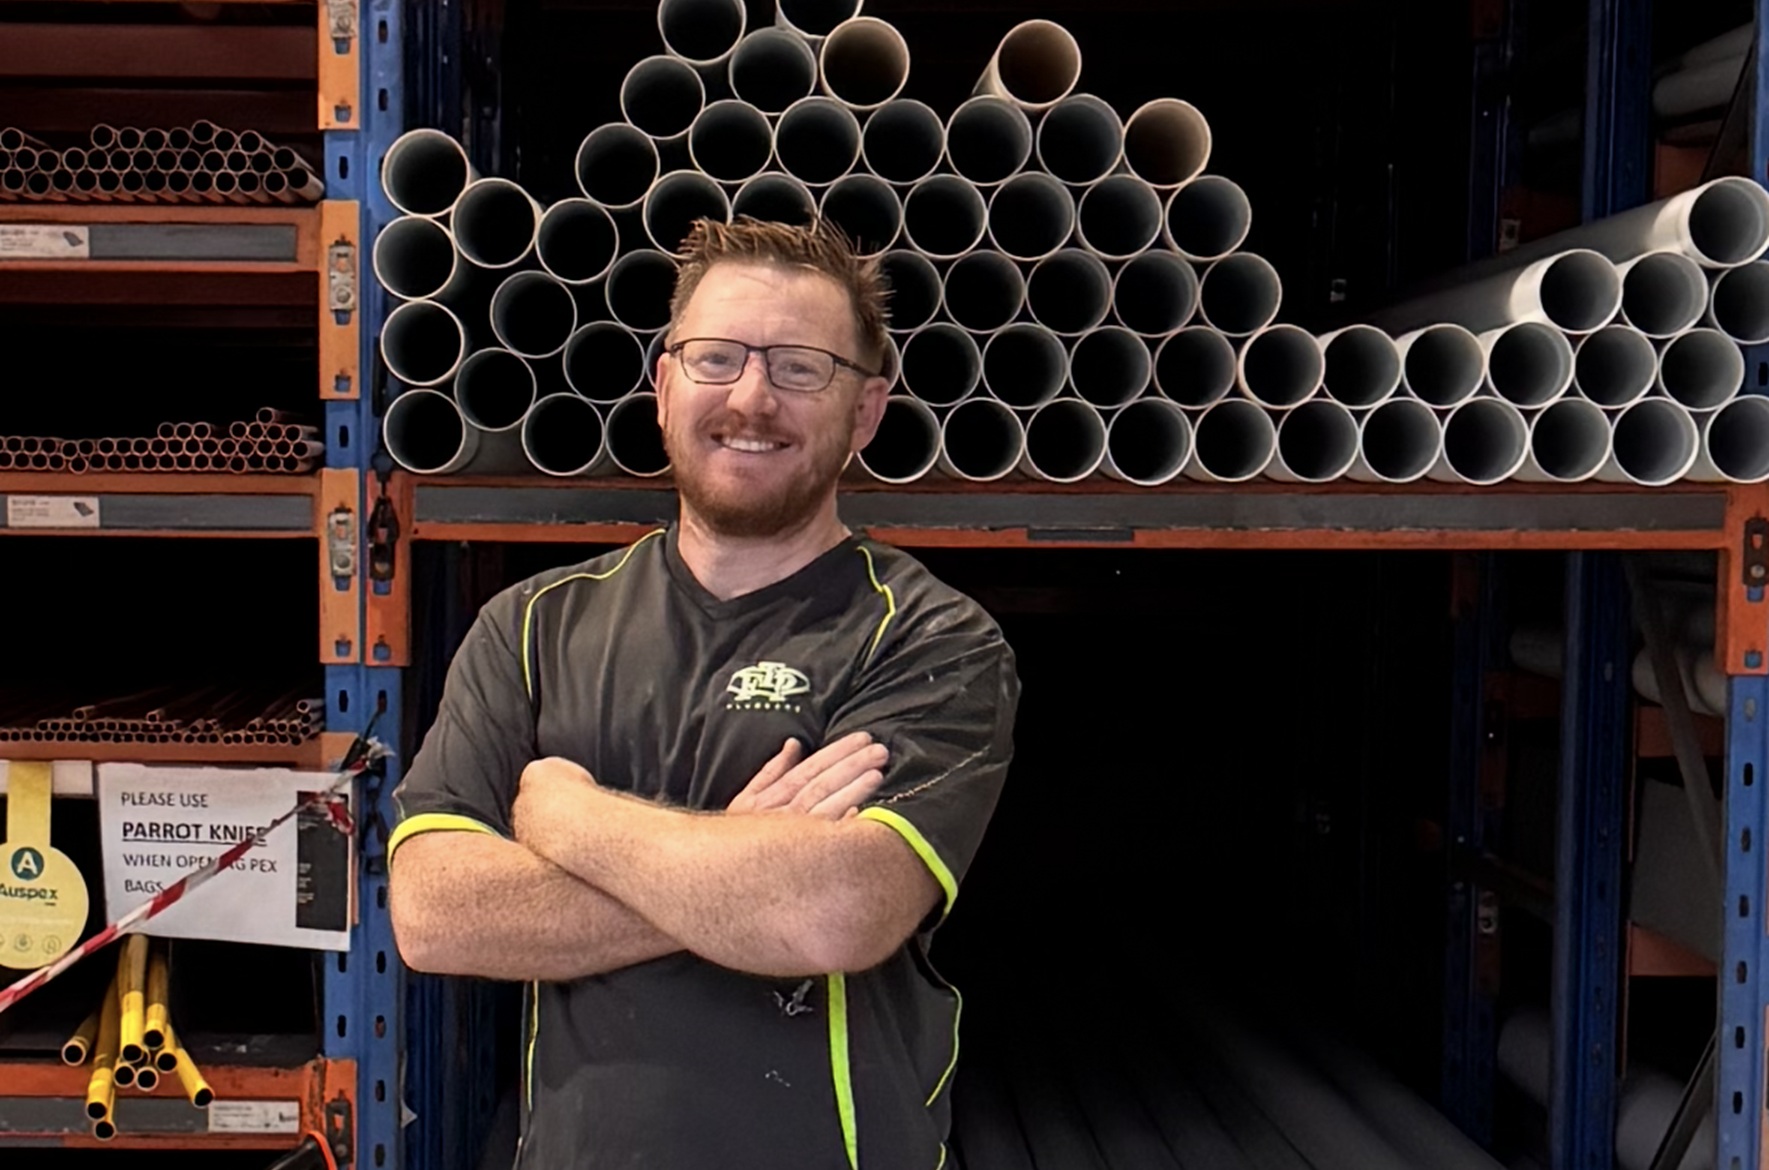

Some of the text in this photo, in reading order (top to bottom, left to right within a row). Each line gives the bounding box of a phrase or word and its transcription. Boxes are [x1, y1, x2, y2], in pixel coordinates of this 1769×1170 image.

[121, 791, 209, 808] PLEASE USE
[122, 821, 203, 840] PARROT
[122, 853, 172, 868] WHEN
[250, 858, 278, 873] PEX
